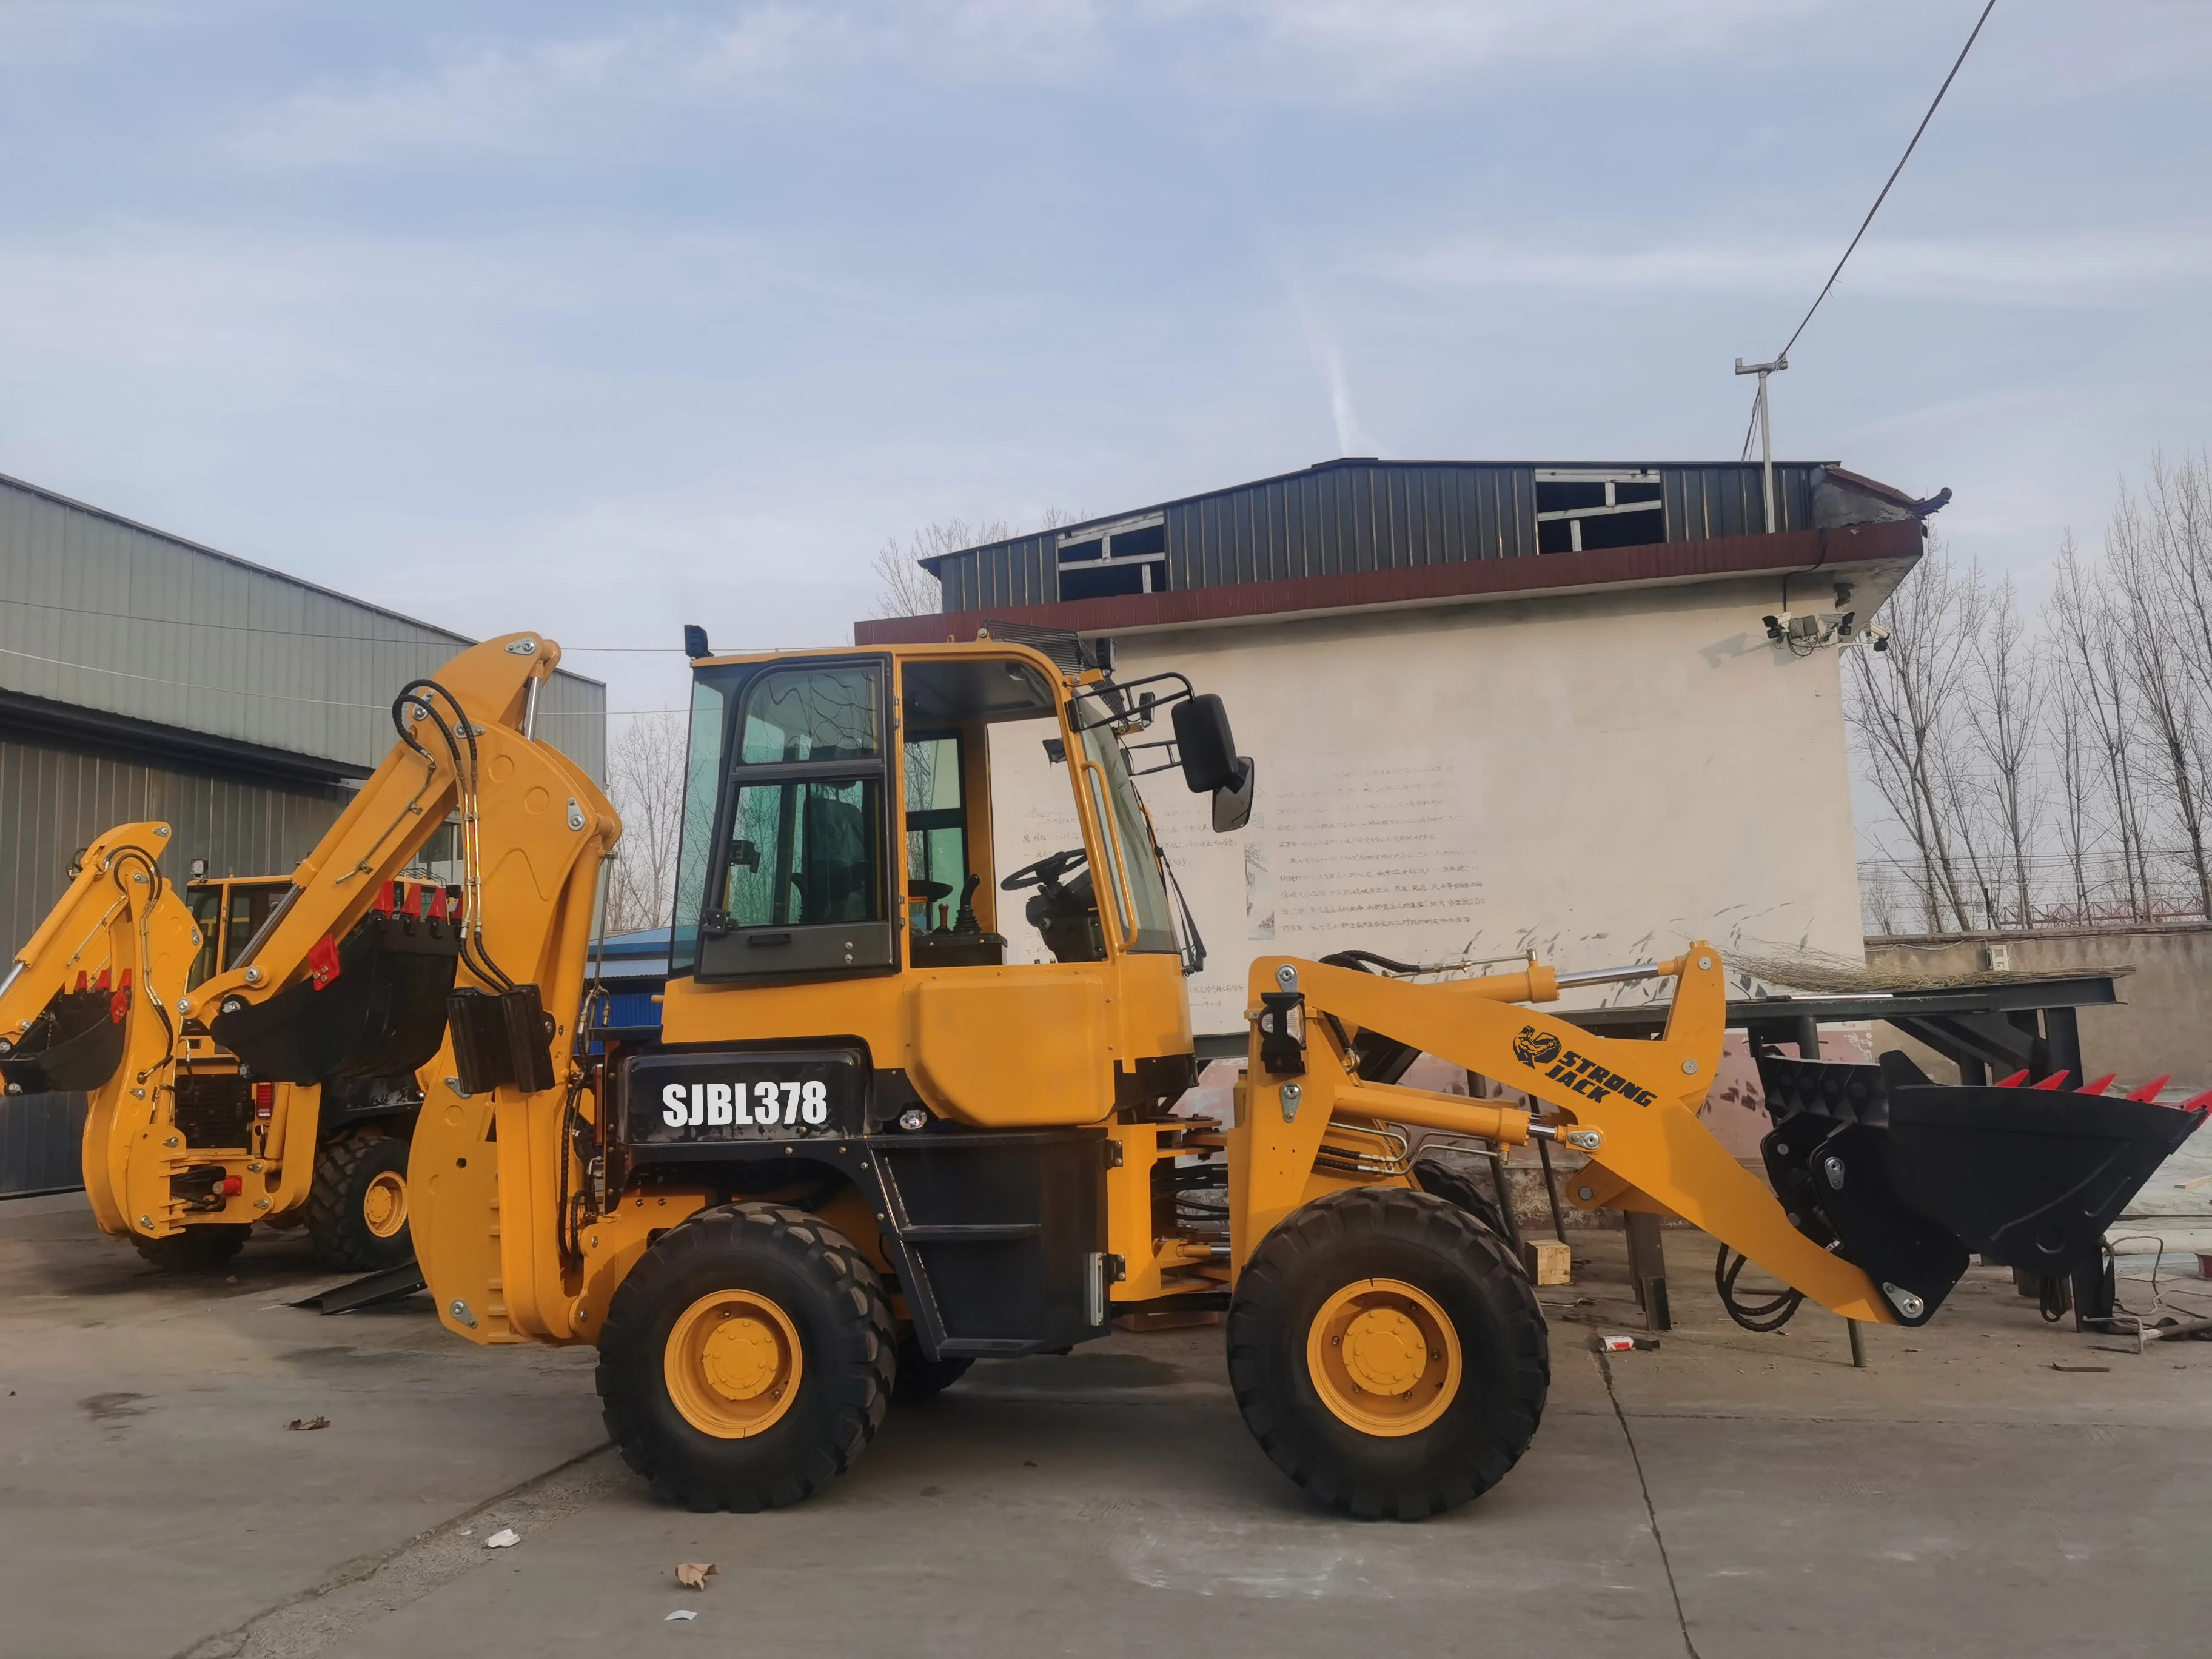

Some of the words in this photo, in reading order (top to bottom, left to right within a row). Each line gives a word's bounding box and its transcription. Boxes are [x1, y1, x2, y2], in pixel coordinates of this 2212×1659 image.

[1544, 1064, 1611, 1104] JACK
[1558, 1050, 1658, 1107] STRONG
[662, 1081, 828, 1127] SJBL378
